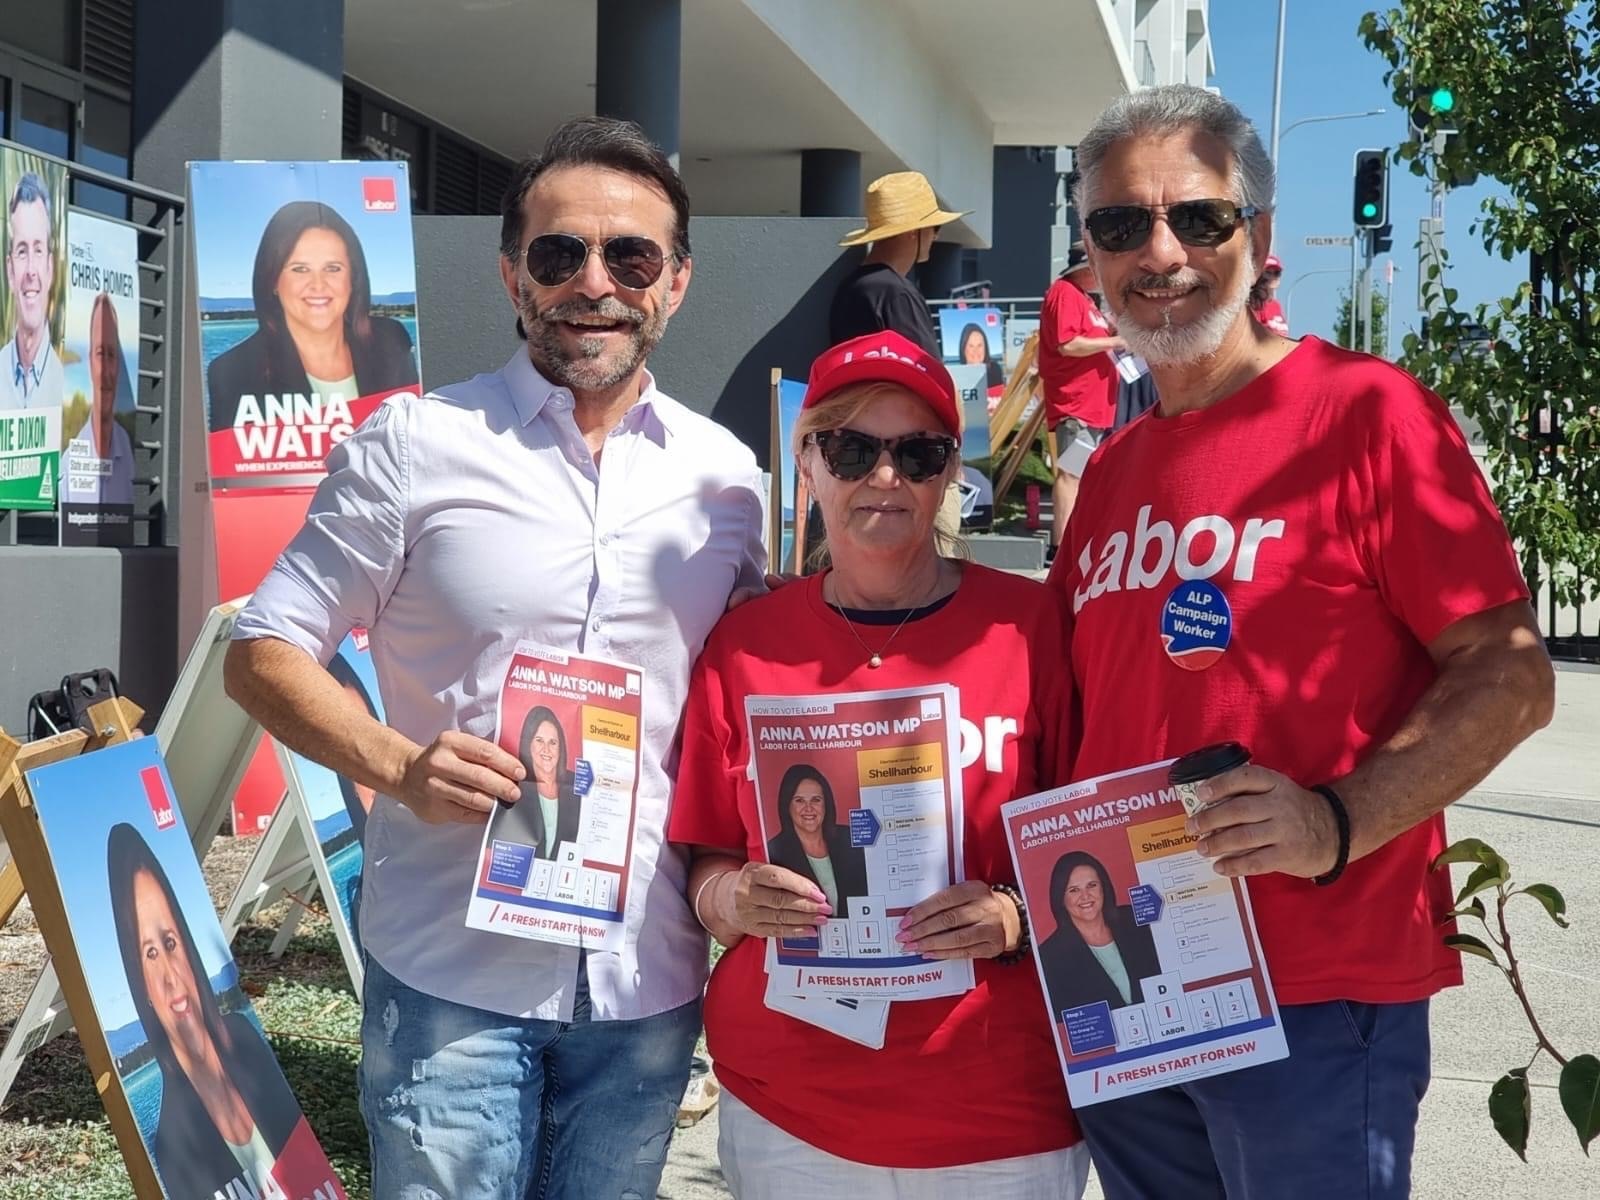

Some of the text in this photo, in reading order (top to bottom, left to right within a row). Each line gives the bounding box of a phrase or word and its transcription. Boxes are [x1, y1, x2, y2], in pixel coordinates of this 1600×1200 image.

[364, 199, 396, 211] Labor
[71, 262, 134, 298] CHRIS HOMER
[233, 392, 354, 428] ANNA
[18, 416, 46, 451] DIXON
[233, 423, 356, 460] WATS
[235, 462, 265, 473] WHEN
[1073, 505, 1286, 615] Labor
[1187, 590, 1212, 606] ALP
[1168, 602, 1228, 626] Campaign
[1173, 620, 1216, 640] Worker
[508, 681, 529, 690] LABOR
[528, 683, 541, 692] FOR
[511, 665, 625, 700] ANNA WATSON MP
[752, 705, 828, 715] HOW TO VOTE LABOR
[590, 724, 631, 742] Shellharbour
[760, 717, 921, 741] ANNA WATSON MP
[783, 742, 799, 750] FOR
[799, 739, 862, 750] SHELLHARBOUR
[868, 765, 933, 779] Shellharbour
[1010, 787, 1091, 815] HOW TO VOTE LABOR
[1021, 813, 1072, 840] ANNA
[1073, 792, 1156, 823] WATSON
[1021, 815, 1131, 849] LABOR FOR SHELLHARBOUR
[1142, 834, 1201, 853] Shellharbo
[567, 852, 575, 861] D
[555, 892, 574, 900] LABOR
[862, 906, 871, 915] D
[502, 912, 509, 922] A
[511, 914, 541, 927] FRESH
[542, 919, 576, 933] START
[574, 924, 588, 935] FOR
[588, 928, 607, 939] NSW
[807, 970, 942, 987] A FRESH START FOR NSW
[1158, 985, 1167, 994] D
[1204, 1010, 1210, 1018] 4
[1161, 1026, 1185, 1037] LABOR
[1107, 1075, 1116, 1086] A
[1117, 1066, 1157, 1083] FRESH
[1158, 1055, 1198, 1073] START
[1200, 1050, 1226, 1064] FOR
[1227, 1041, 1257, 1057] NSW
